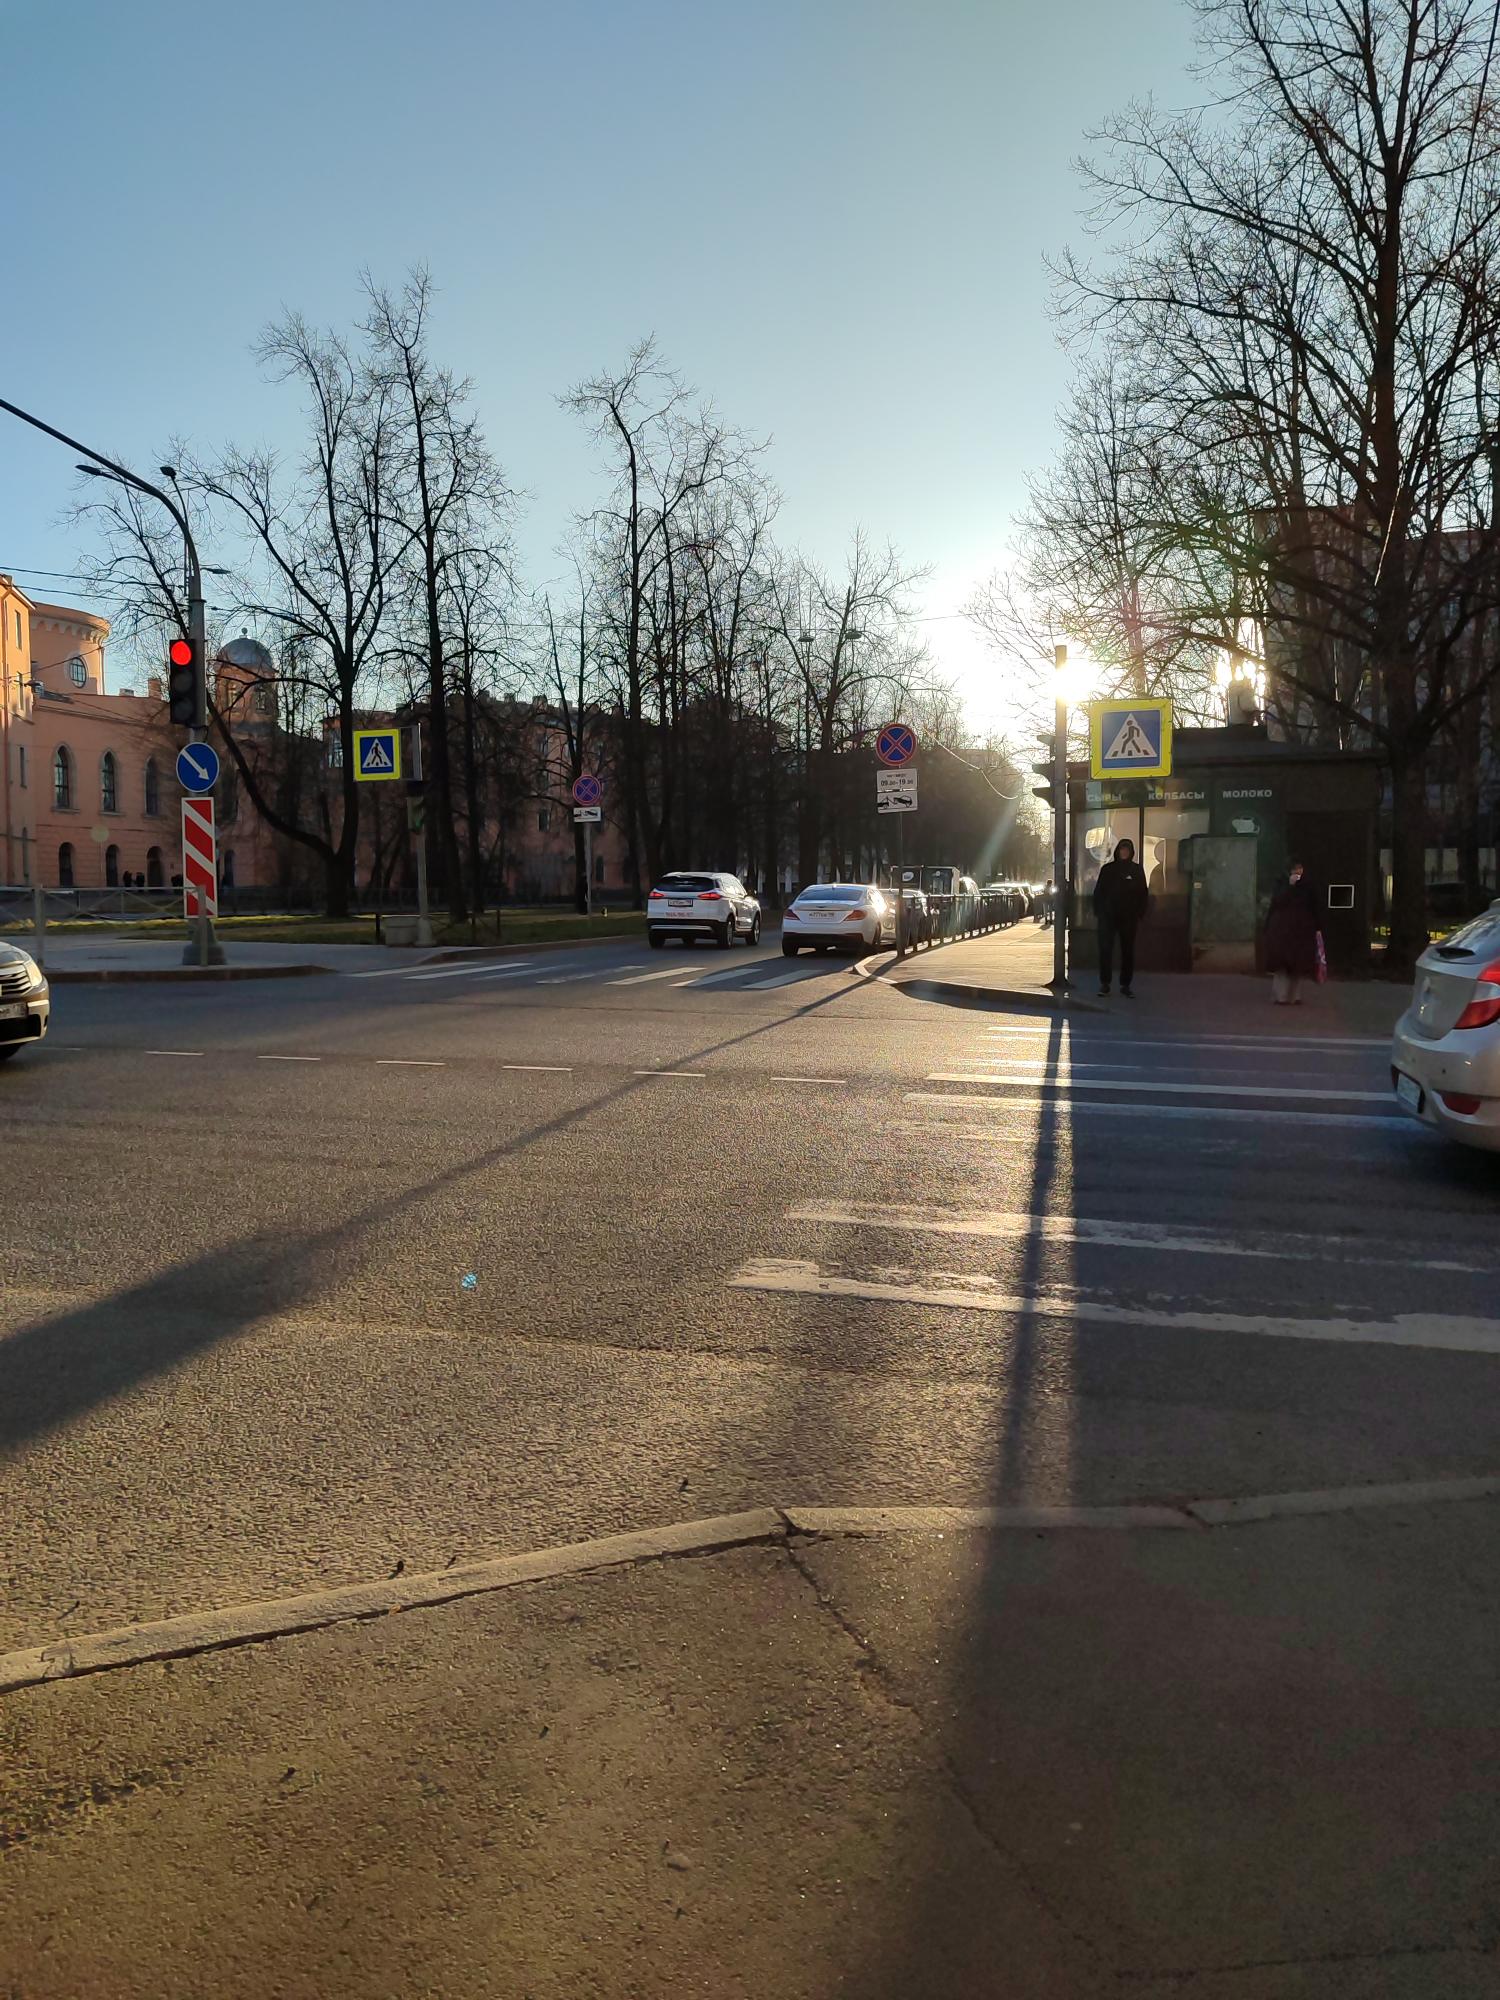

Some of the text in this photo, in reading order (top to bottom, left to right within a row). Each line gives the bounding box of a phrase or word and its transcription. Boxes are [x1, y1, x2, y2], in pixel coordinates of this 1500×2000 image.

[1087, 789, 1272, 801] СЫРЫ КОЛБАСЫ МОЛОКО
